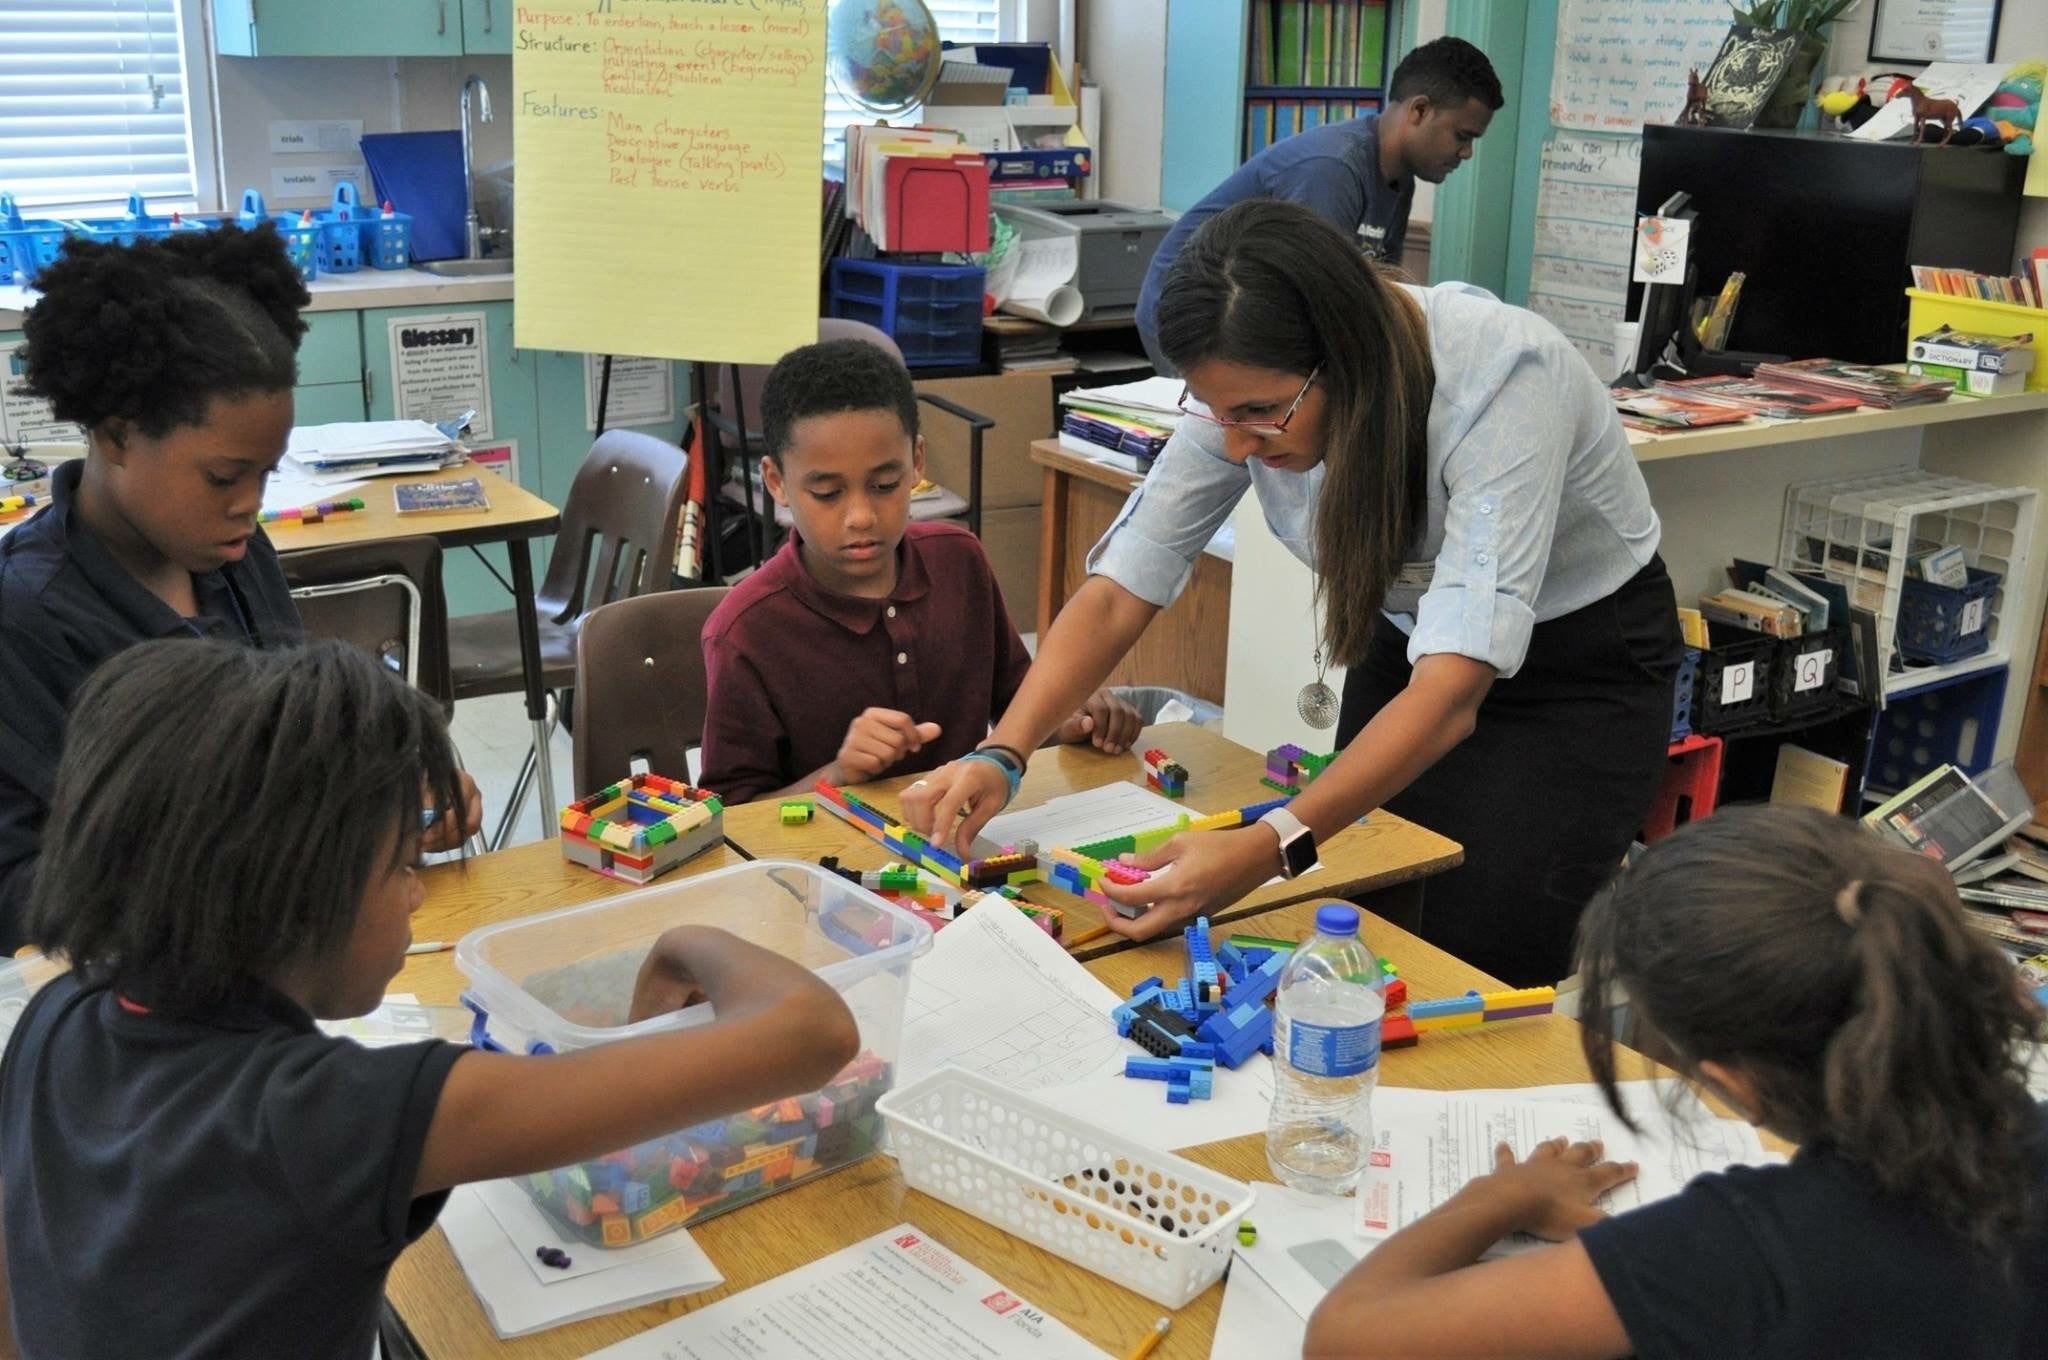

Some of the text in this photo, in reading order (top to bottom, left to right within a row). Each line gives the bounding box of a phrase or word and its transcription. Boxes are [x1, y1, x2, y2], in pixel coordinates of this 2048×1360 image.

[517, 8, 581, 30] Purpose:
[586, 12, 600, 27] To
[516, 29, 598, 53] Structure:
[675, 57, 716, 71] event
[522, 89, 605, 120] Features:
[608, 111, 643, 133] Main
[401, 327, 475, 349] Glossary
[1967, 602, 1979, 631] R
[1732, 666, 1746, 700] P
[1802, 657, 1818, 686] Q
[1007, 1313, 1043, 1339] Florida
[1020, 1308, 1045, 1325] AIA
